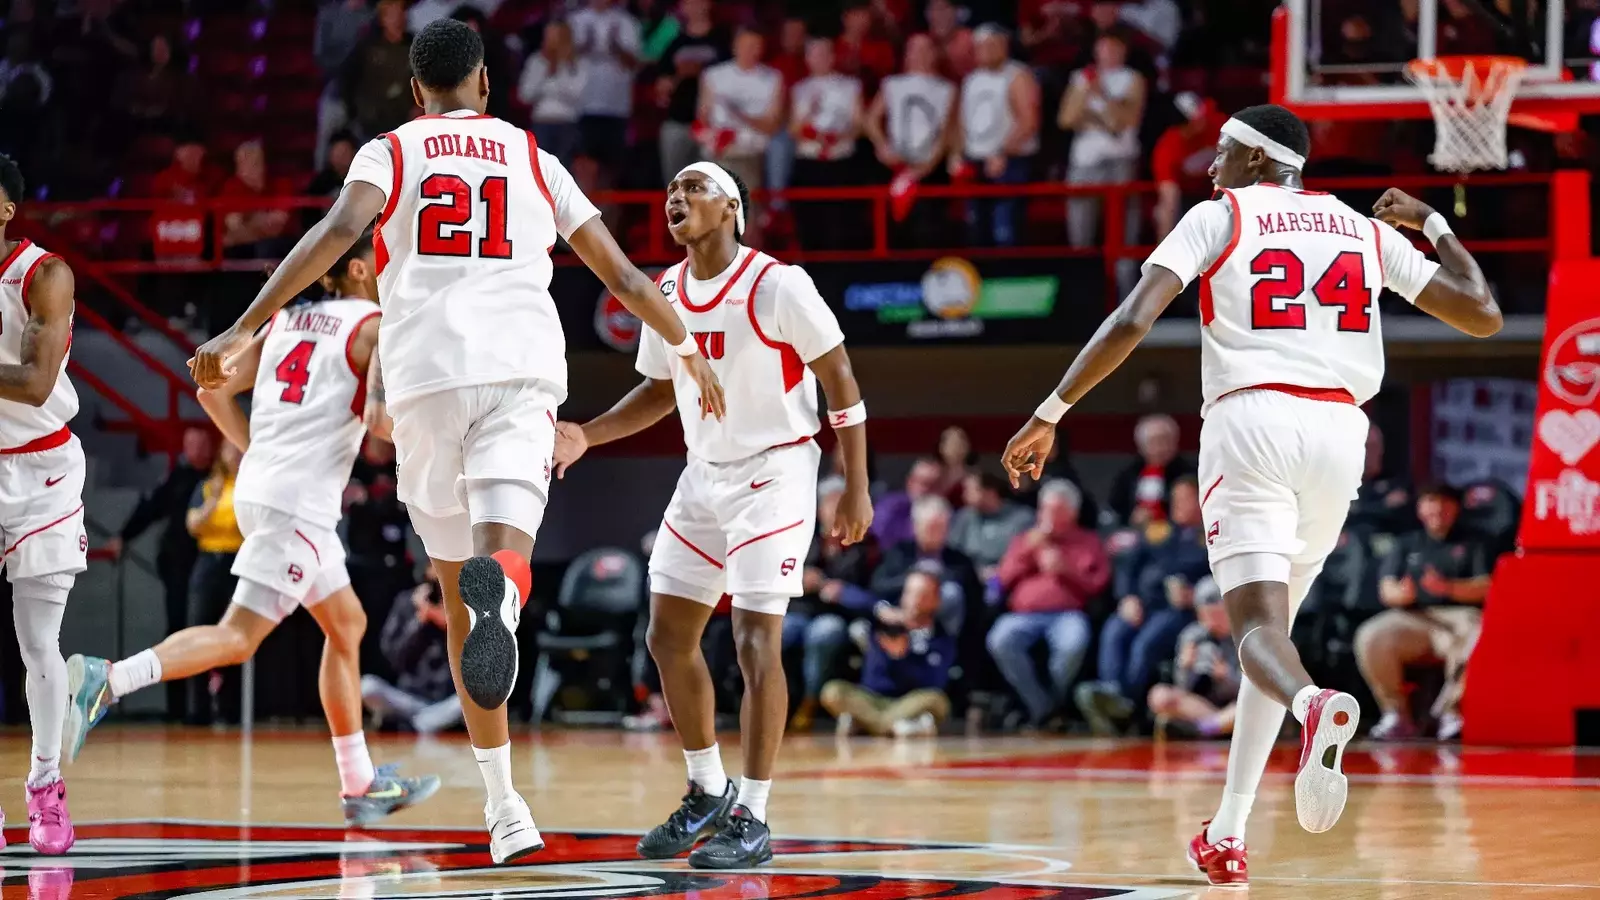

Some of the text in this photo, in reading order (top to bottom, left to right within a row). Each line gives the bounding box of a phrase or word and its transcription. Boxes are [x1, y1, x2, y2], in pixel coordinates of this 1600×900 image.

[423, 134, 507, 166] ODIAHI
[417, 173, 512, 259] 21
[1256, 212, 1363, 241] MARSHALL
[662, 281, 674, 294] 45
[1250, 248, 1372, 333] 24
[284, 311, 342, 336] LANDER
[690, 331, 725, 360] KU
[275, 340, 317, 405] 4
